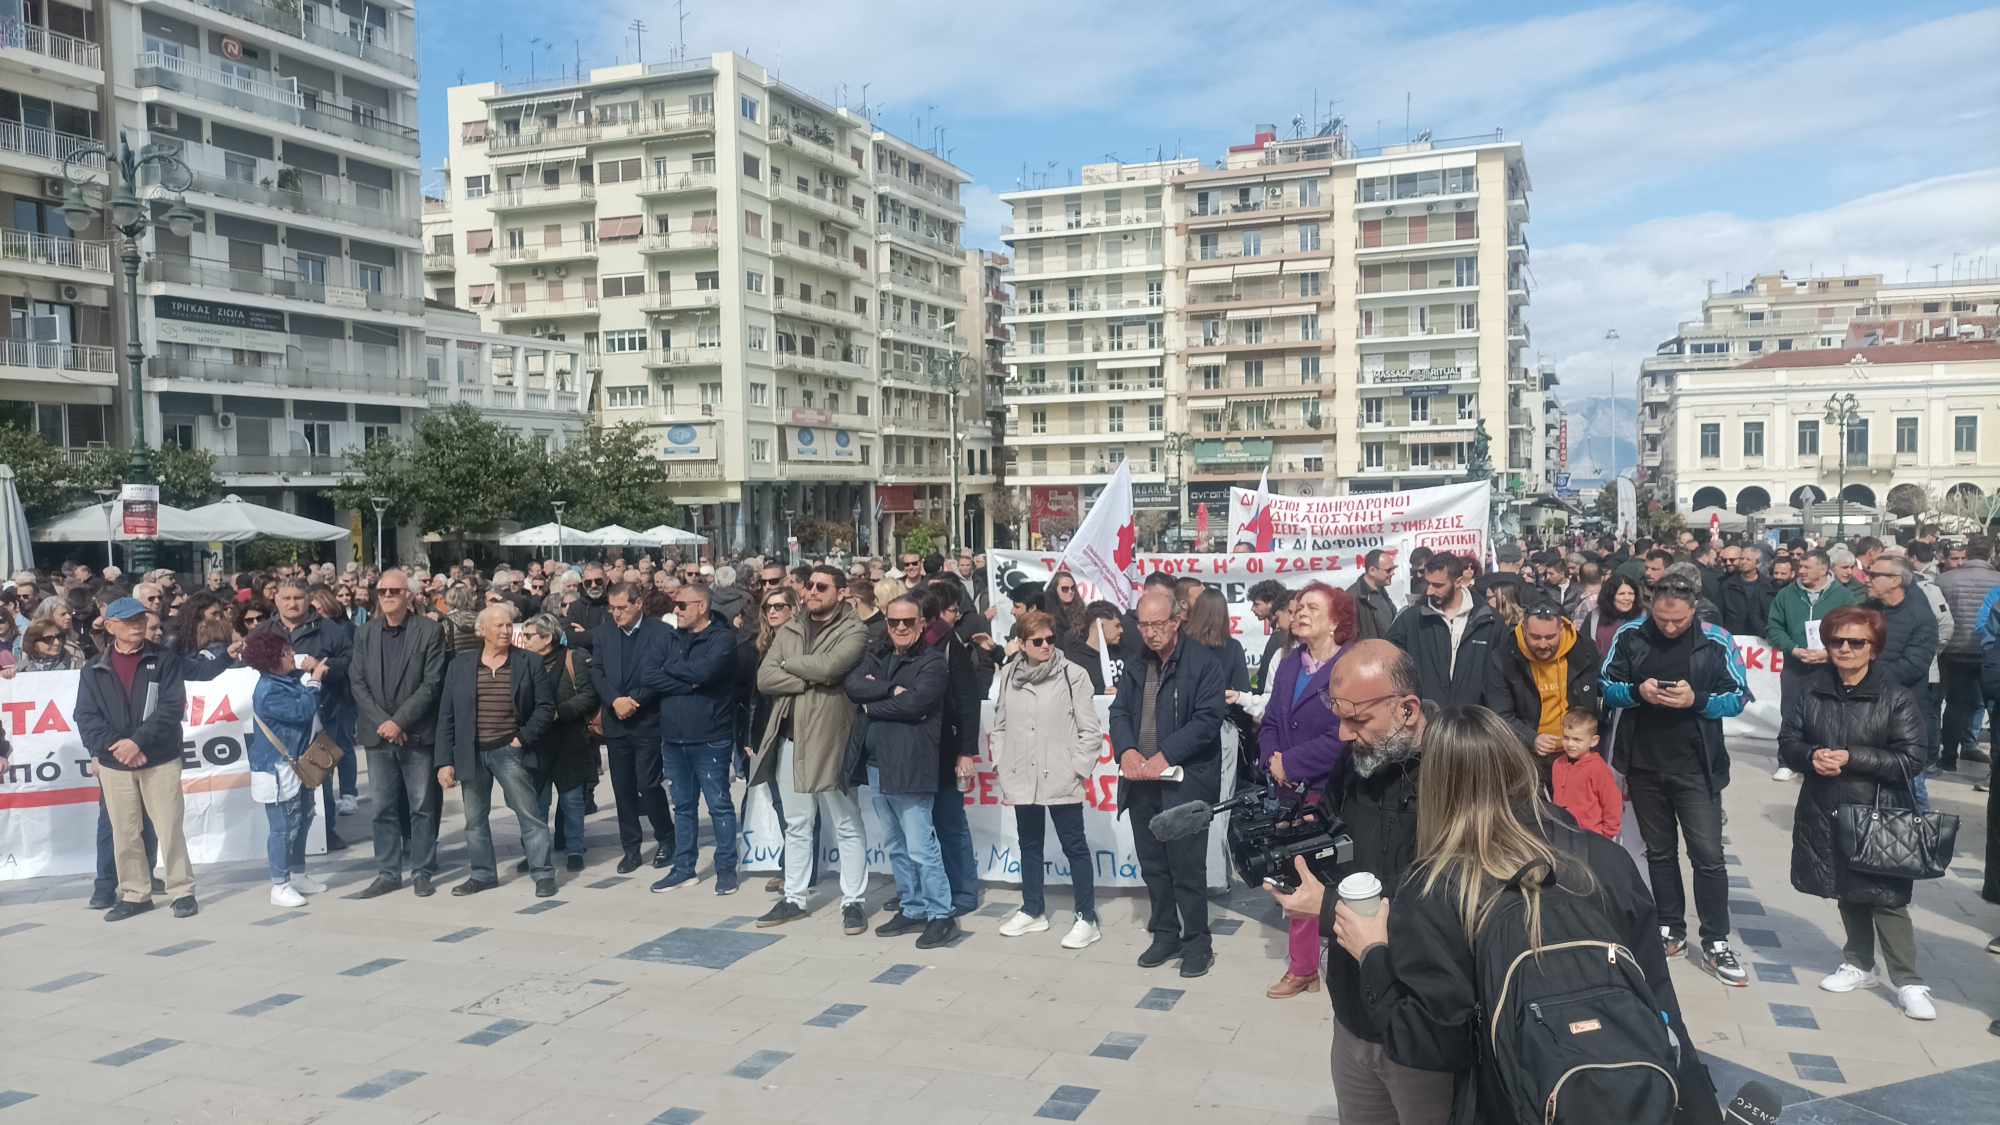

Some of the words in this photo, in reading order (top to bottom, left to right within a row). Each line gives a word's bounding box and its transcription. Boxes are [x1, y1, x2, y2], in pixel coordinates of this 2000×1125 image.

[1271, 510, 1382, 524] ΔΙΚΑΙΟΣΥΝΗ
[1390, 515, 1464, 533] ΣΥΜΒΑΣΕΙΣ
[1149, 558, 1202, 575] ΤΟΥΣ
[1246, 556, 1264, 574] ΟΙ
[1275, 555, 1342, 573] ΖΩΕΣ
[0, 752, 61, 784] πό
